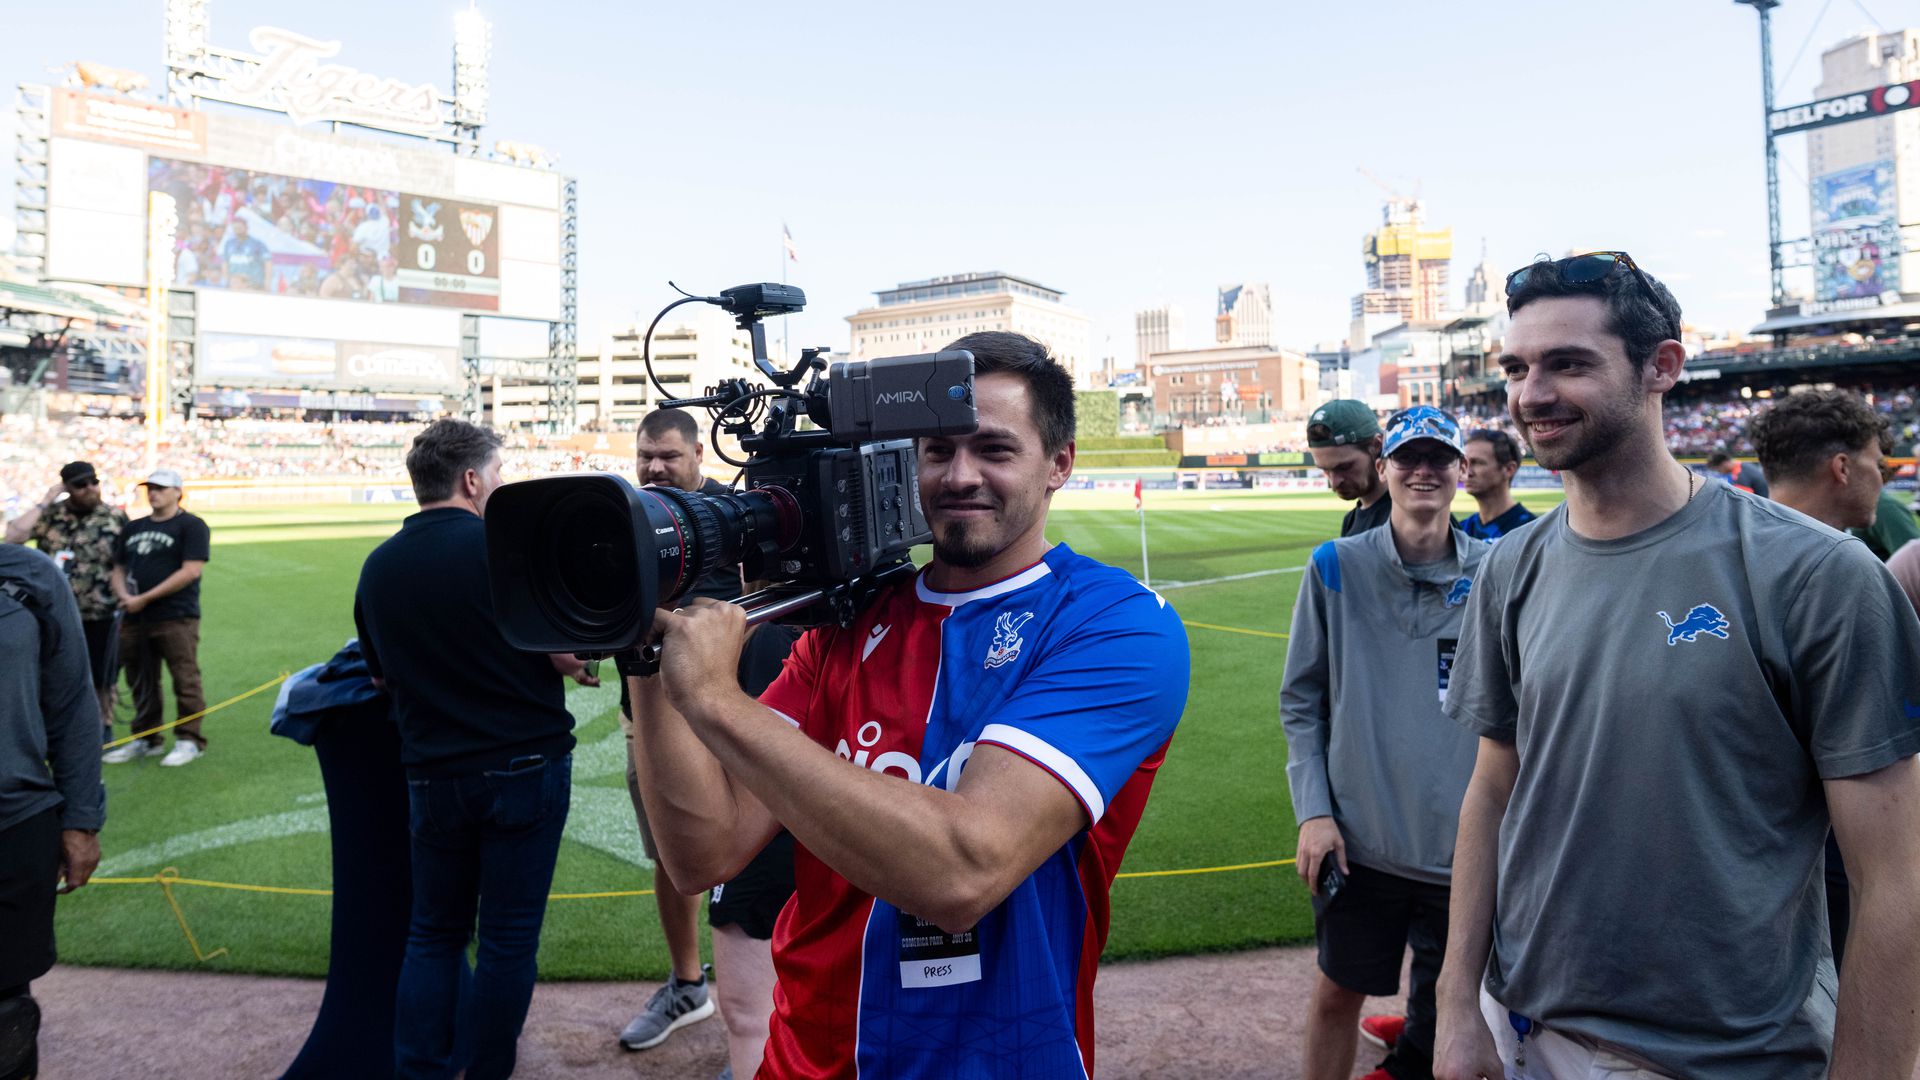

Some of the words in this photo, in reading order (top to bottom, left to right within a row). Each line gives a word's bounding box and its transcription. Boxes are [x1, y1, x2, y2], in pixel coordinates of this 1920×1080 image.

[229, 26, 444, 130] Tigers
[1771, 95, 1867, 130] BELFOR
[417, 244, 435, 270] 0
[467, 250, 485, 275] 0
[876, 390, 925, 404] AMIRA
[655, 526, 675, 535] Canon
[660, 546, 680, 558] 17-120
[930, 936, 944, 946] PARK
[924, 964, 952, 978] PRESS
